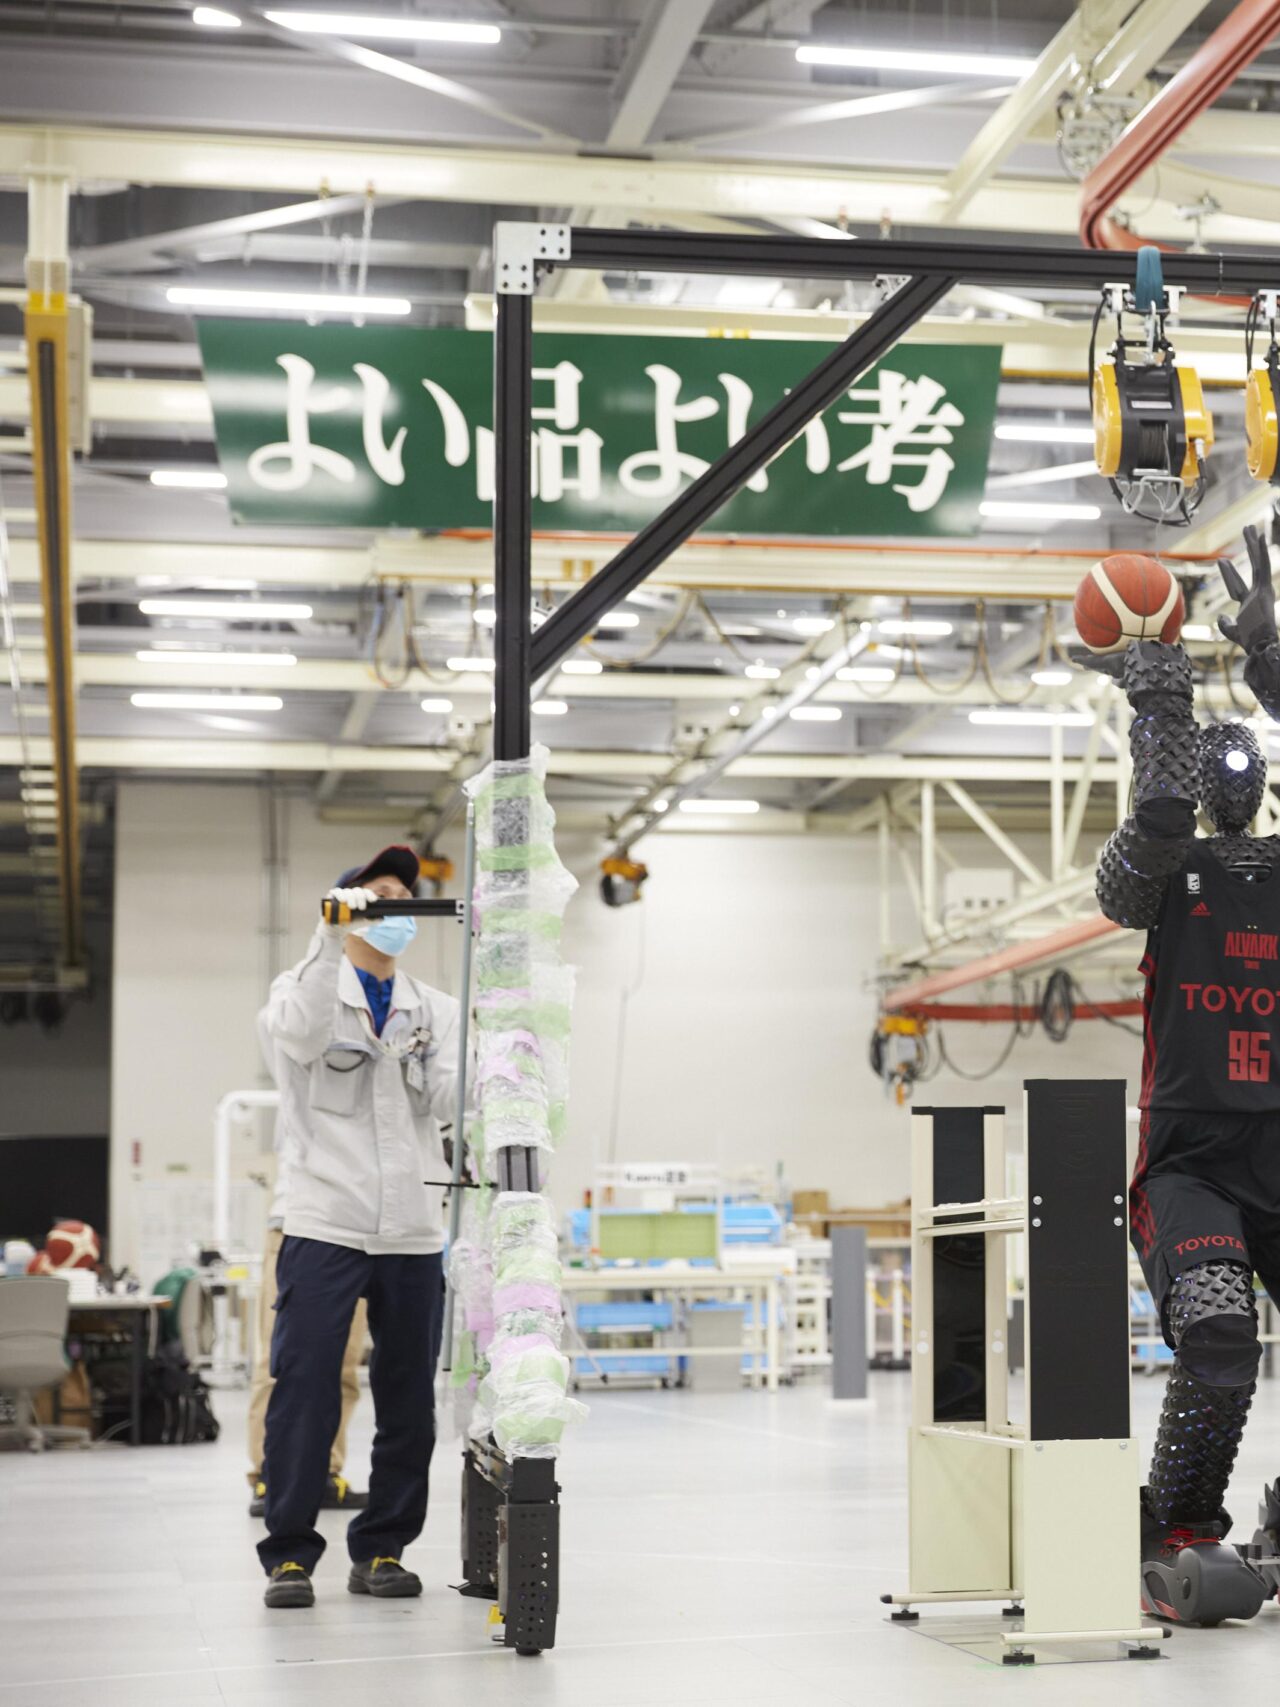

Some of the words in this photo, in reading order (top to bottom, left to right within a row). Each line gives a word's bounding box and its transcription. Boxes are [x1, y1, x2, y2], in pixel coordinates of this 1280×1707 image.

[1225, 931, 1278, 960] ALVARK
[1229, 1030, 1270, 1082] 95
[1174, 1235, 1245, 1256] TOYOTA
